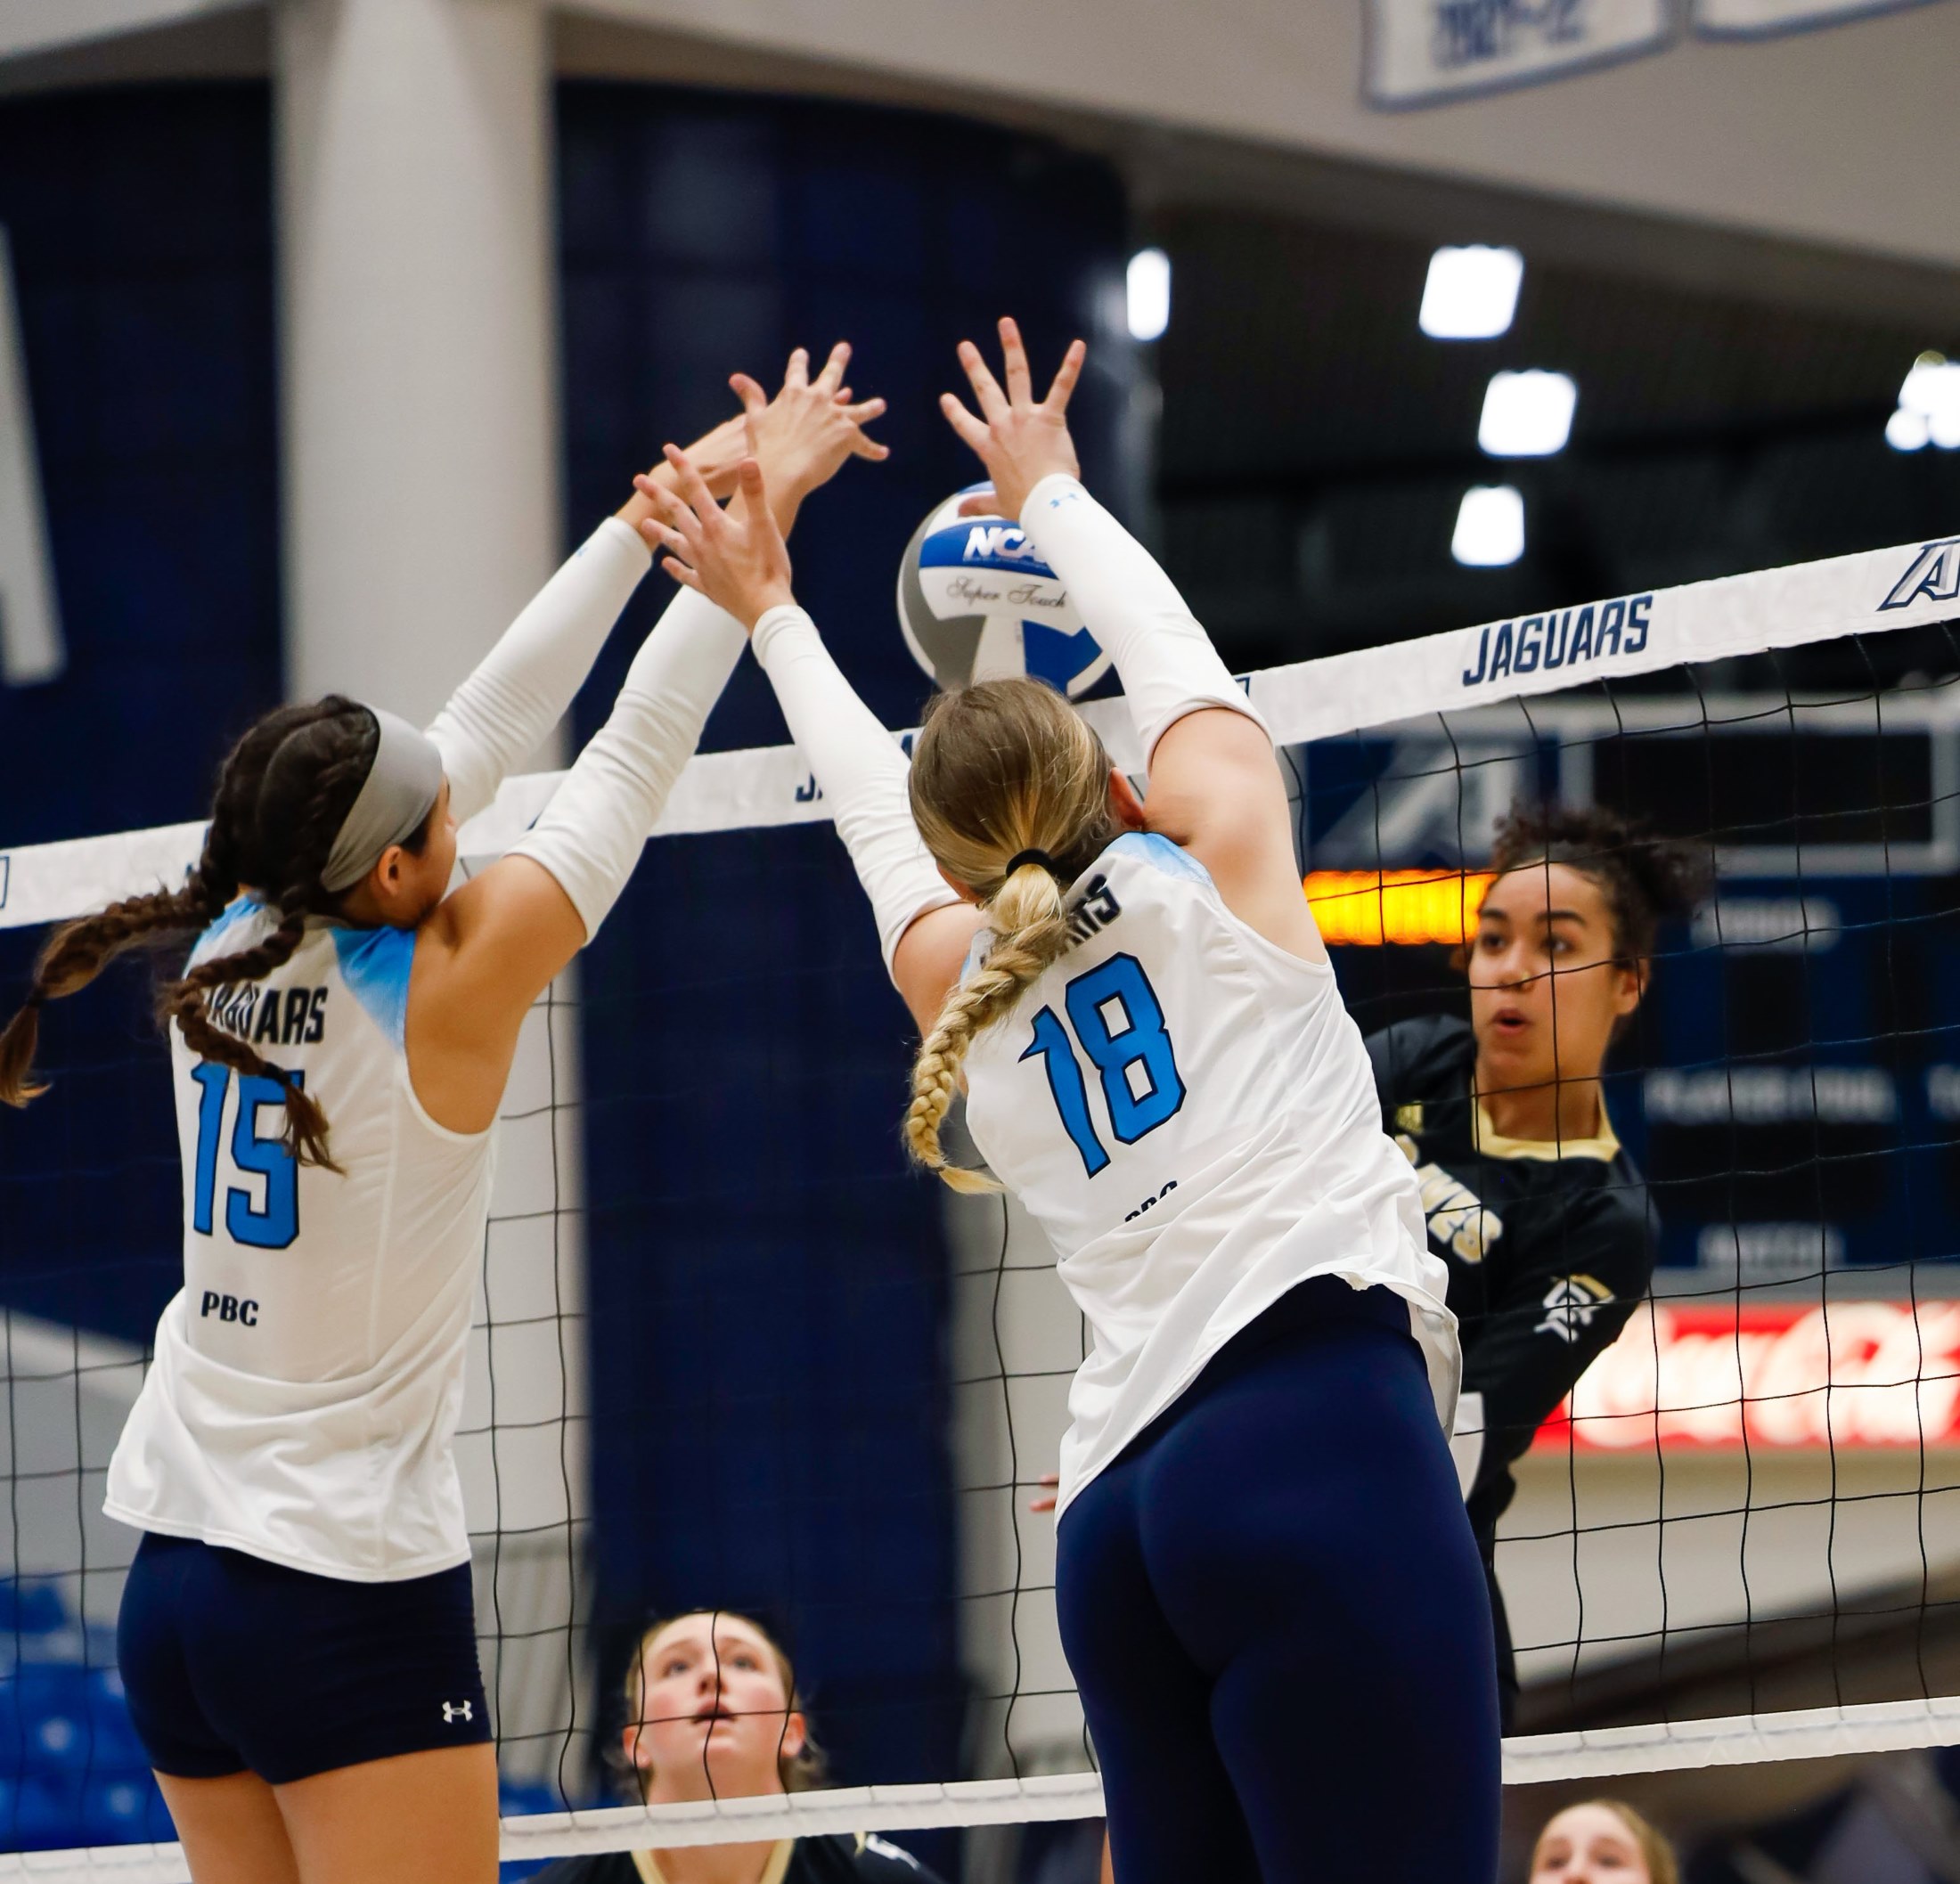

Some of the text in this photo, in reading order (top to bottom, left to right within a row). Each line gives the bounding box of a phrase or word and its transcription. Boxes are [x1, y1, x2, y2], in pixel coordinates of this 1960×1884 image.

[962, 526, 1049, 564] NCA
[946, 575, 1067, 608] Super Touch
[1462, 594, 1654, 687] JAGUARS
[208, 983, 329, 1045] AGUARS
[1017, 950, 1188, 1179] 18
[190, 1060, 306, 1251] 15
[200, 1290, 259, 1327] PBC
